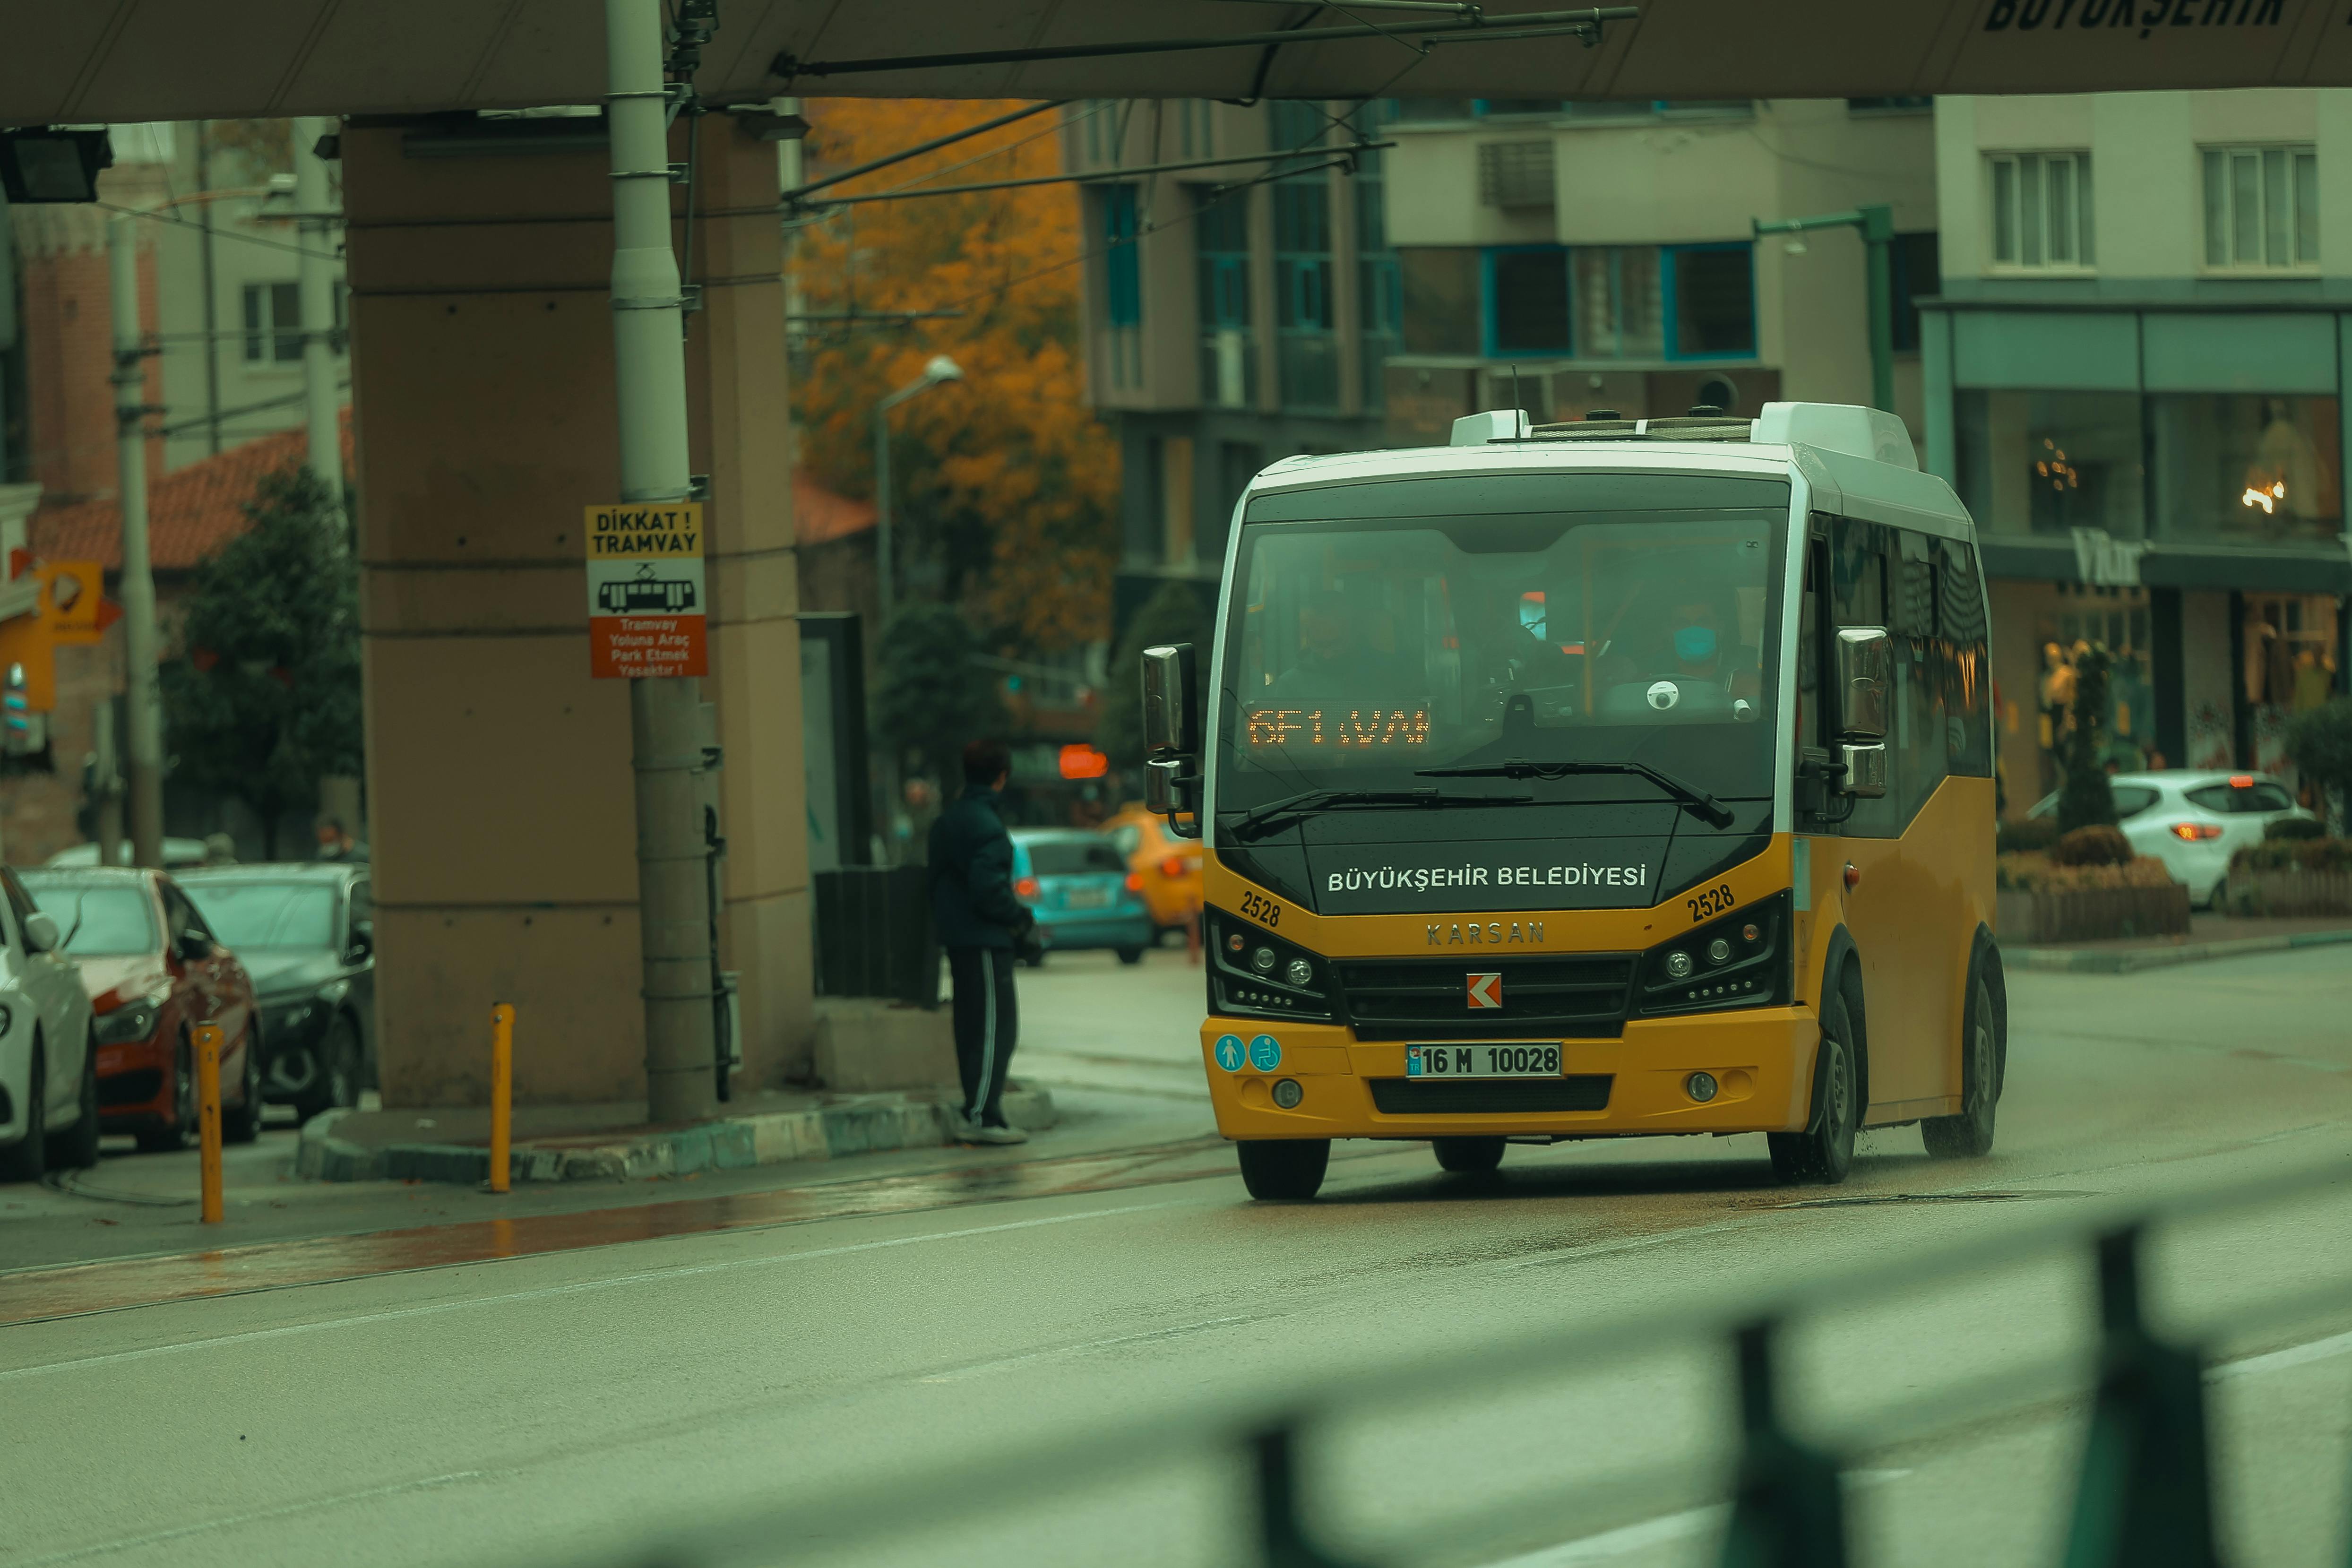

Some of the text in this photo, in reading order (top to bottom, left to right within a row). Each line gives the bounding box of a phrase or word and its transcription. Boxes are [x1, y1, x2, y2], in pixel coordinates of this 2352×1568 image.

[597, 509, 677, 532] DİKKAT
[593, 533, 697, 553] TRAMVAY
[620, 618, 678, 633] Tramvay
[610, 633, 690, 648] Yoluna Araç
[612, 648, 689, 662] Park Etmek
[1328, 862, 1646, 892] BÜYÜKŞEHİR BELEDİYESİ
[1240, 890, 1281, 928] 2528
[1687, 884, 1735, 923] 2528
[1427, 922, 1544, 945] KARSAN
[1423, 1047, 1559, 1074] 16 M 10028
